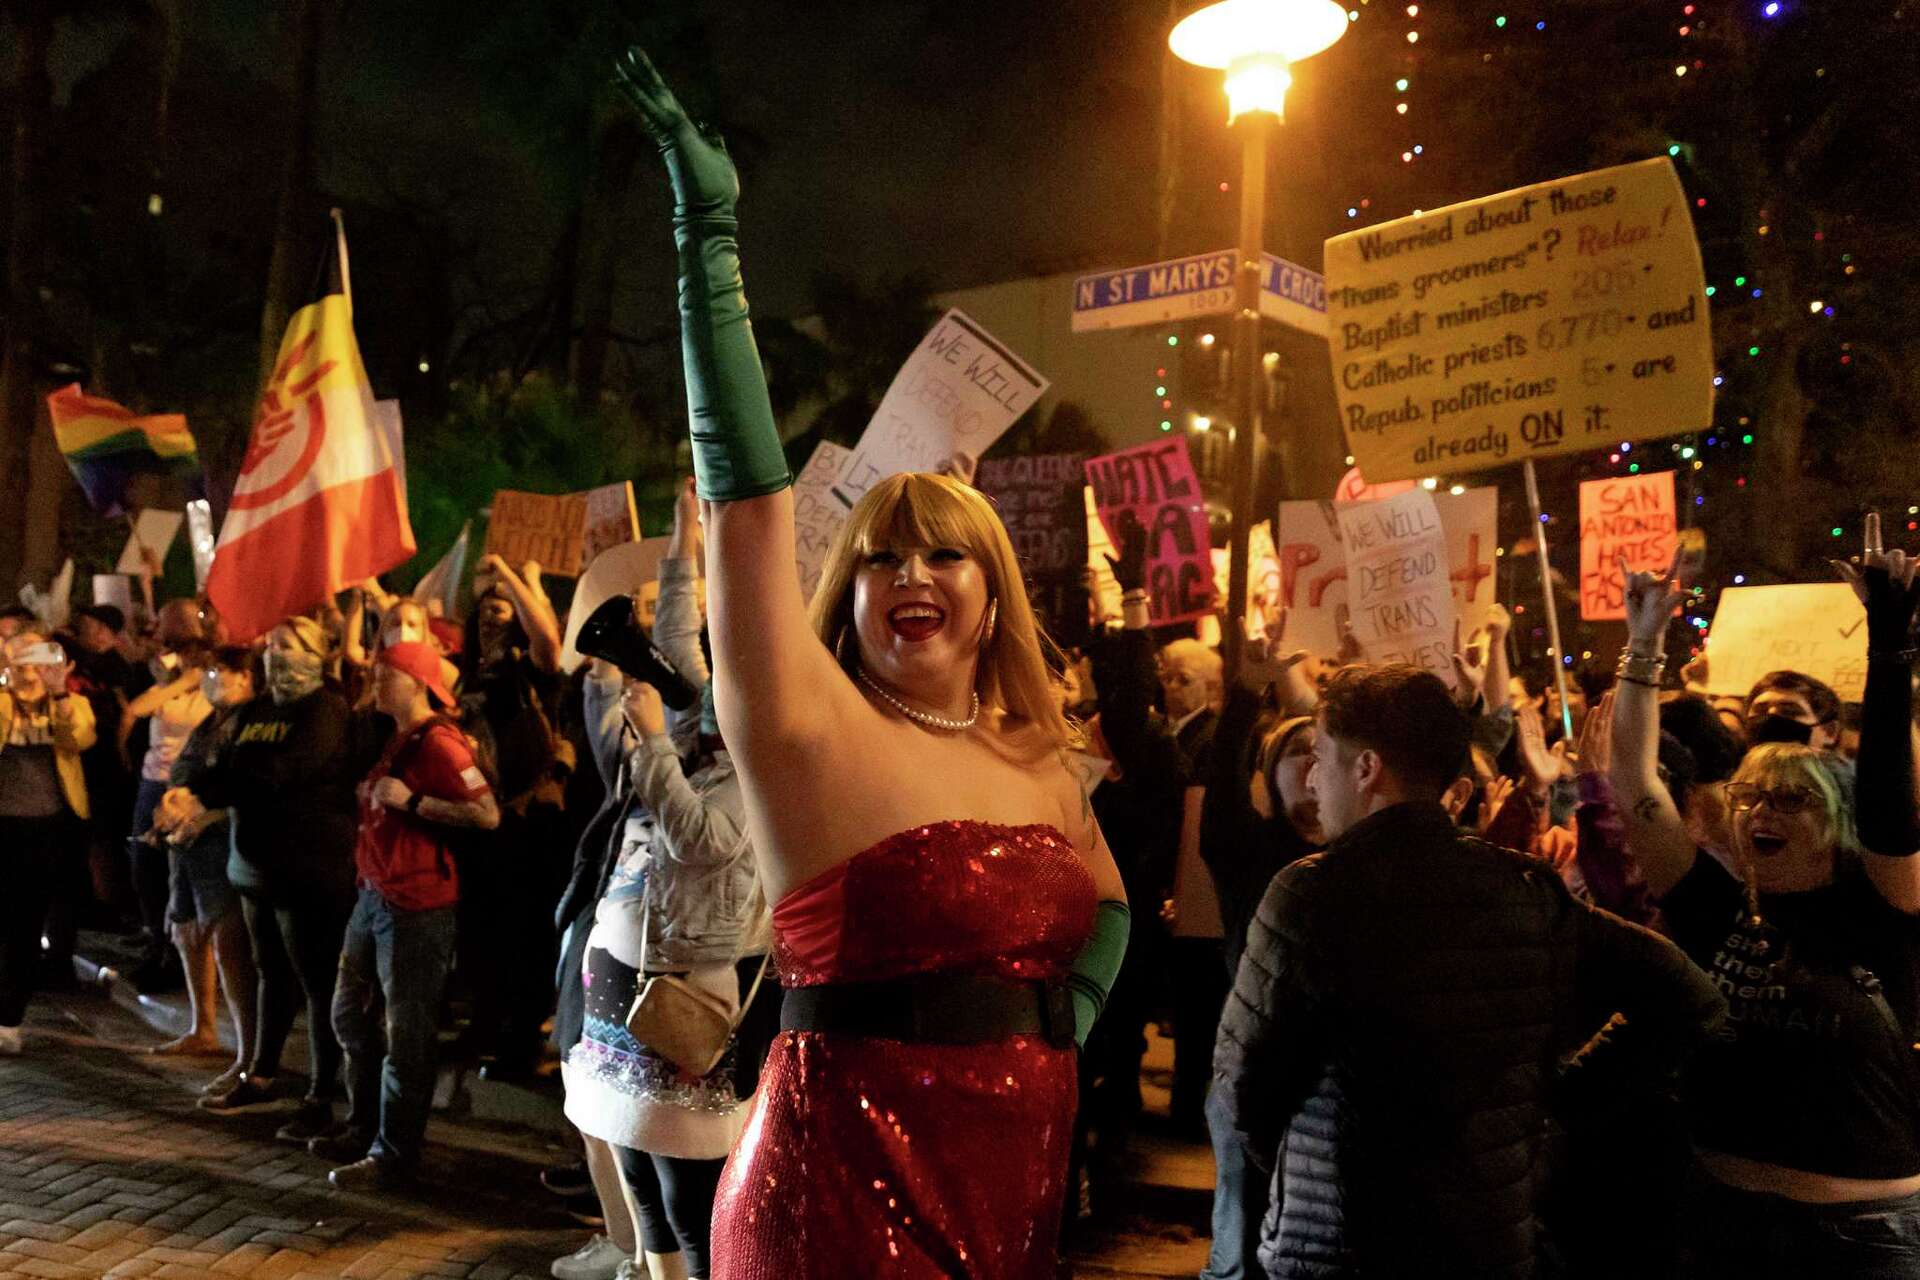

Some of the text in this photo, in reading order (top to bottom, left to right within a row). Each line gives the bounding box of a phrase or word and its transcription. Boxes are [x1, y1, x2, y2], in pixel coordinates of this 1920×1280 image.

[1357, 186, 1616, 262] Worried about those
[1079, 256, 1231, 308] N ST MARYS
[1280, 266, 1328, 312] CROC
[1342, 310, 1427, 350] Baptist
[1436, 289, 1548, 329] ministers
[1342, 354, 1433, 391] Catholic
[1445, 334, 1528, 378] priests
[1648, 293, 1695, 330] and
[928, 325, 1020, 413] WE WILL
[1431, 377, 1557, 424] politicians
[1632, 355, 1677, 379] are
[1414, 425, 1509, 465] already
[1520, 409, 1564, 446] ON
[1600, 484, 1660, 514] SAN
[1344, 521, 1375, 552] WE
[1375, 507, 1436, 540] WILL
[1598, 537, 1666, 569] HATES
[1359, 550, 1437, 600] DEFEND
[1362, 594, 1439, 637] TRANS
